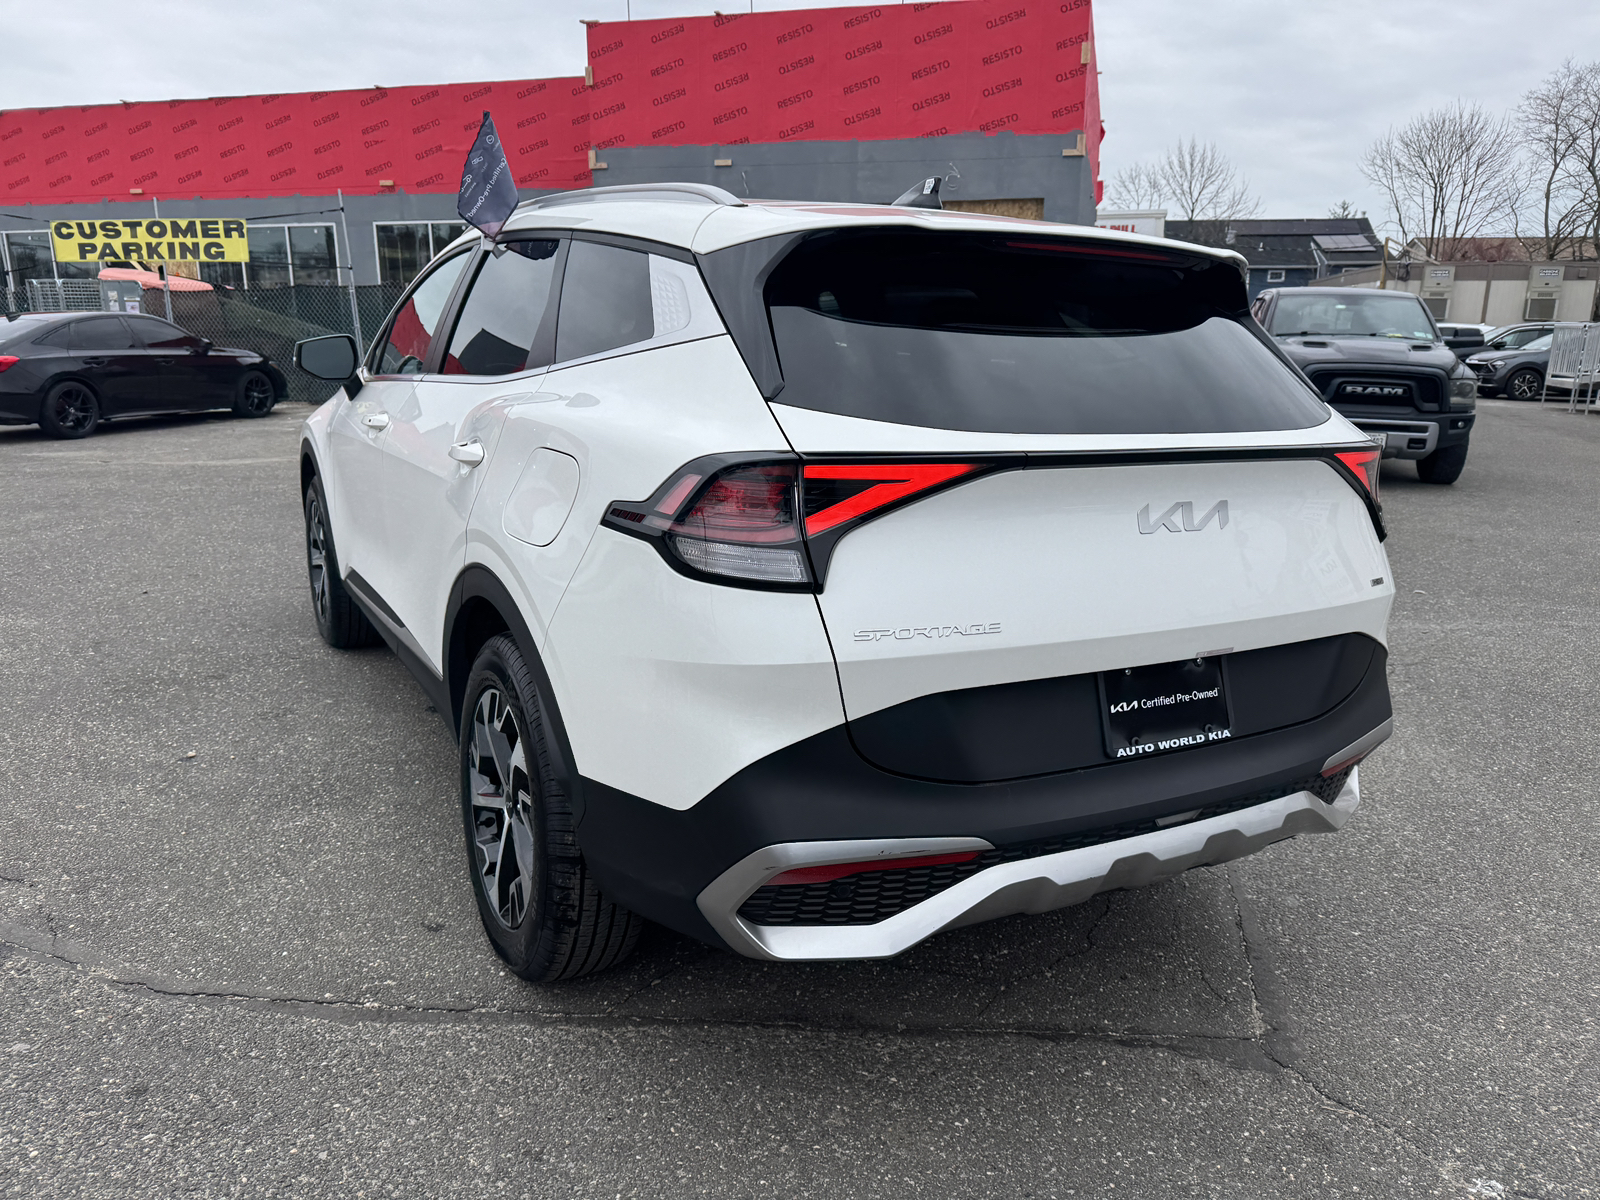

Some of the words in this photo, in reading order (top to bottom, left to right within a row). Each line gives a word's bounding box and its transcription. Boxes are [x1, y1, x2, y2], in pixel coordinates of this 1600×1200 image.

[843, 8, 882, 30] RESISTO
[985, 8, 1027, 30] RESISTO
[651, 23, 685, 44] RESISTO
[776, 23, 813, 45] RESISTO
[913, 23, 953, 45] RESISTO
[1056, 31, 1089, 51] RESIST
[590, 39, 624, 59] RESISTO
[712, 42, 748, 62] RESISTO
[844, 40, 883, 61] RESISTO
[981, 45, 1023, 66] RESISTO
[650, 57, 684, 77] RESISTO
[778, 54, 815, 75] RESISTO
[911, 59, 950, 81] RESISTO
[517, 82, 547, 100] RESISTO
[714, 72, 750, 92] RESISTO
[843, 75, 881, 96] RESISTO
[982, 77, 1023, 98] RESISTO
[360, 90, 388, 107] RESISTO
[412, 89, 440, 106] RESISTO
[463, 85, 493, 103] RESISTO
[652, 87, 687, 107] RESISTO
[777, 89, 813, 110] RESISTO
[912, 91, 951, 112] RESISTO
[313, 111, 340, 128] RESISTO
[592, 101, 626, 121] RESISTO
[712, 106, 748, 126] RESISTO
[844, 106, 882, 126] RESISTO
[1051, 100, 1085, 119] RESIST
[218, 116, 244, 132] RESISTO
[265, 114, 291, 130] RESISTO
[362, 119, 389, 136] RESISTO
[412, 118, 441, 135] RESISTO
[517, 112, 547, 129] RESISTO
[651, 120, 686, 140] RESISTO
[778, 119, 815, 139] RESISTO
[979, 113, 1019, 132] RESISTO
[174, 145, 200, 161] RESISTO
[220, 143, 245, 159] RESISTO
[267, 141, 293, 158] RESISTO
[314, 139, 340, 155] RESISTO
[415, 144, 443, 161] RESISTO
[519, 139, 549, 155] RESISTO
[223, 168, 249, 183] RESISTO
[270, 167, 296, 182] RESISTO
[317, 164, 344, 180] RESISTO
[365, 160, 393, 177] RESISTO
[519, 168, 549, 184] RESISTO
[416, 173, 444, 189] RESISTO
[53, 220, 246, 240] CUSTOMER
[78, 241, 226, 260] PARKING
[1345, 386, 1404, 396] RAM
[853, 621, 1002, 642] SPORTAGE
[1141, 694, 1175, 709] Certified
[1176, 688, 1219, 703] Pre-Owned
[1117, 743, 1155, 757] AUTO
[1157, 734, 1205, 750] WORLD
[1208, 729, 1231, 741] KIA
